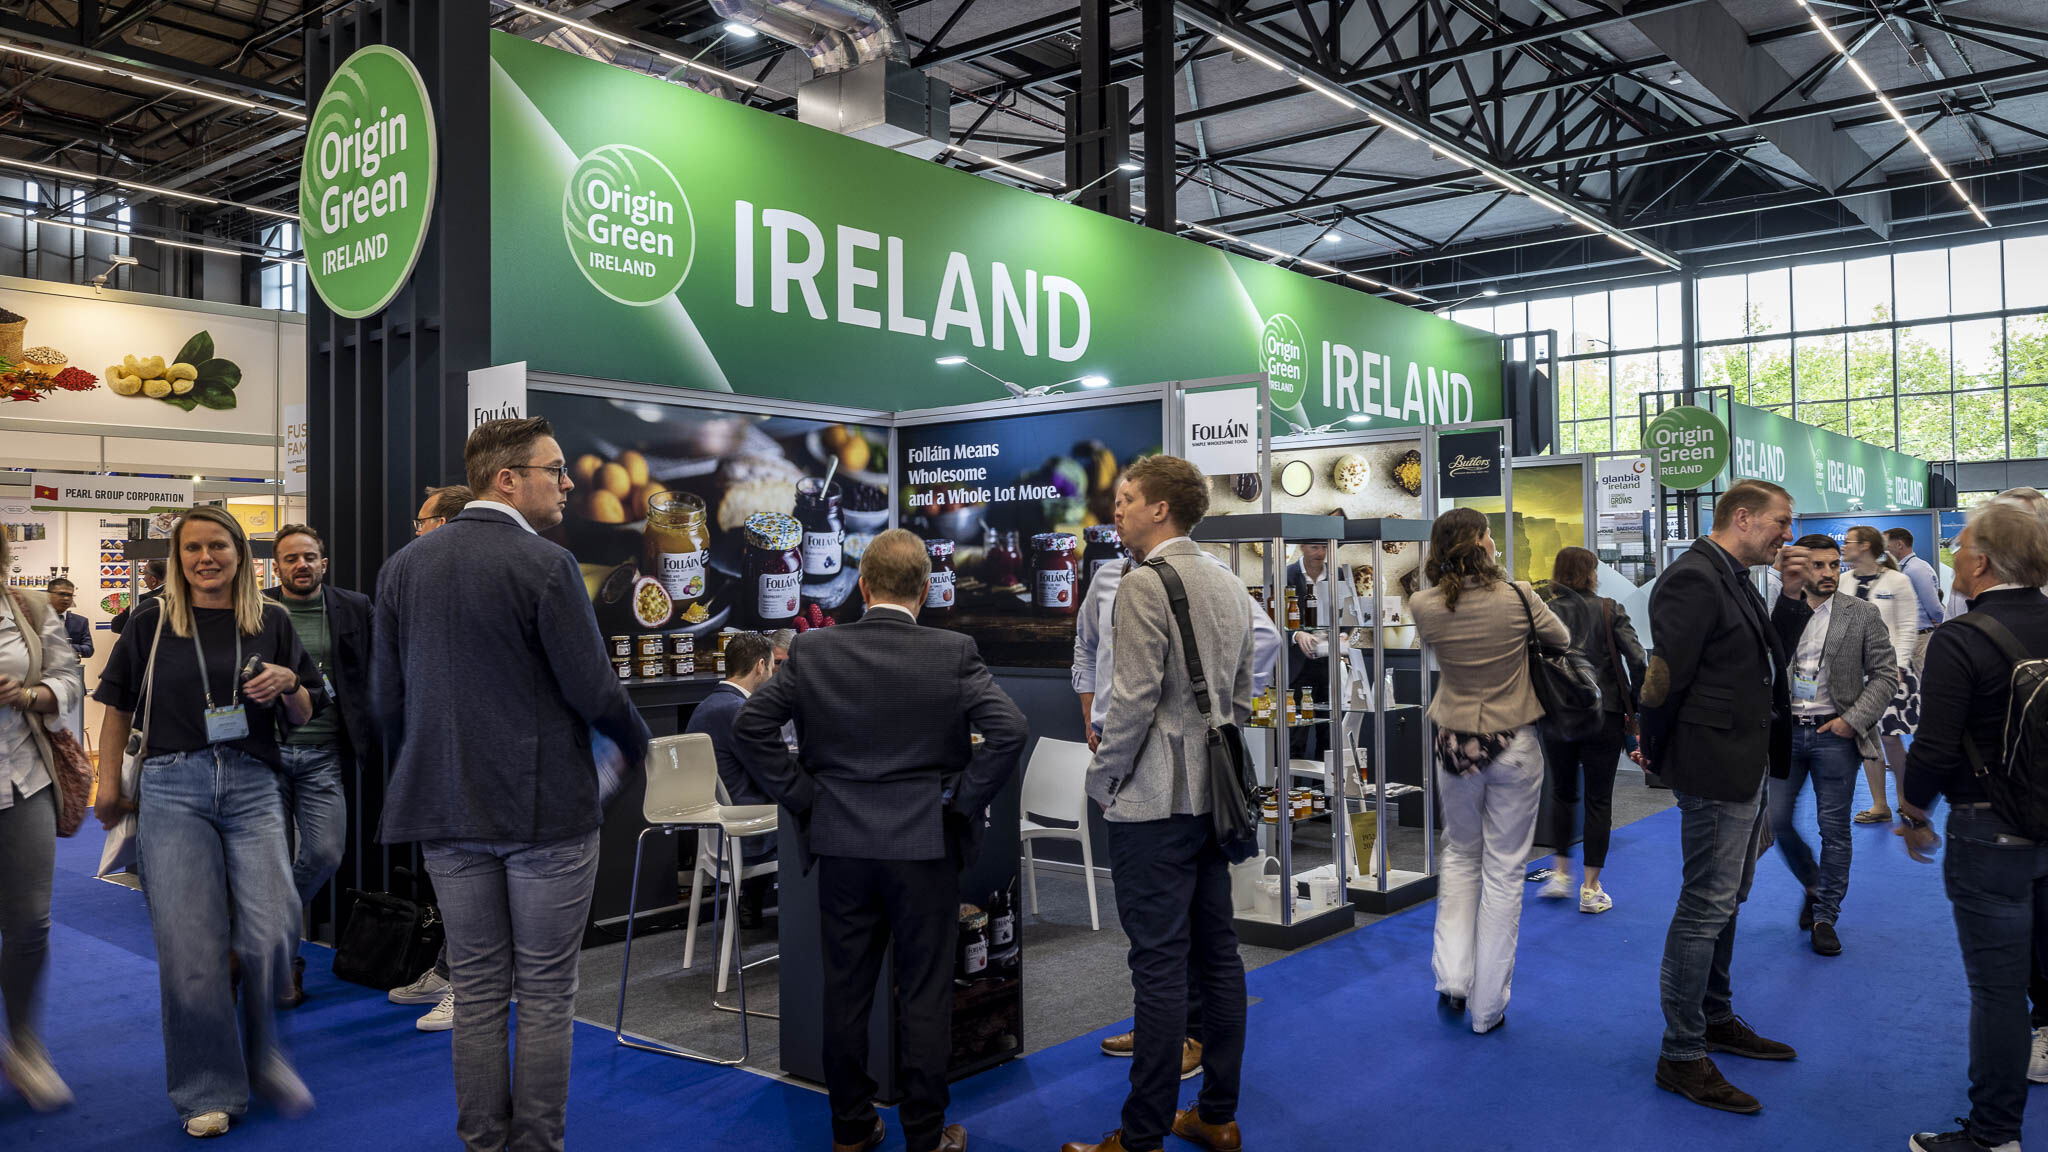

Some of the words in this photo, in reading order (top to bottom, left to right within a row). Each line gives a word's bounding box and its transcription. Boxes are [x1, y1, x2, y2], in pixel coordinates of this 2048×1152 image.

[320, 106, 407, 180] Origin
[320, 171, 407, 234] Green
[587, 179, 674, 226] Origin
[587, 213, 674, 257] Green
[322, 233, 388, 276] IRELAND
[590, 251, 656, 278] IRELAND
[735, 200, 1092, 362] IRELAND
[1268, 336, 1300, 362] Origin
[1268, 357, 1300, 380] Green
[1269, 380, 1294, 392] RELAND
[1322, 340, 1473, 425] IRELAND
[1192, 418, 1249, 441] FOLLÁIN
[1656, 425, 1714, 447] Origin
[908, 445, 950, 463] Folláin
[953, 443, 1000, 460] Means
[1448, 454, 1491, 469] Butlers
[1658, 446, 1714, 463] Green
[1736, 436, 1785, 482] RELAND
[908, 467, 987, 485] Wholesome
[1602, 473, 1640, 485] glanbia
[1608, 481, 1640, 490] ireland
[1827, 459, 1866, 497] IRELAND
[65, 488, 93, 499] PEARL
[95, 489, 125, 500] GROUP
[126, 491, 184, 503] CORPORATION
[909, 489, 933, 507] and
[936, 492, 945, 505] a
[947, 487, 991, 504] Whole
[994, 486, 1015, 502] Lot
[1018, 484, 1061, 501] More.
[1895, 476, 1924, 507] IRELAND
[664, 555, 700, 570] FOLLÁIN
[766, 576, 797, 589] FOLLÁIN
[930, 573, 950, 584] OLLÁIN
